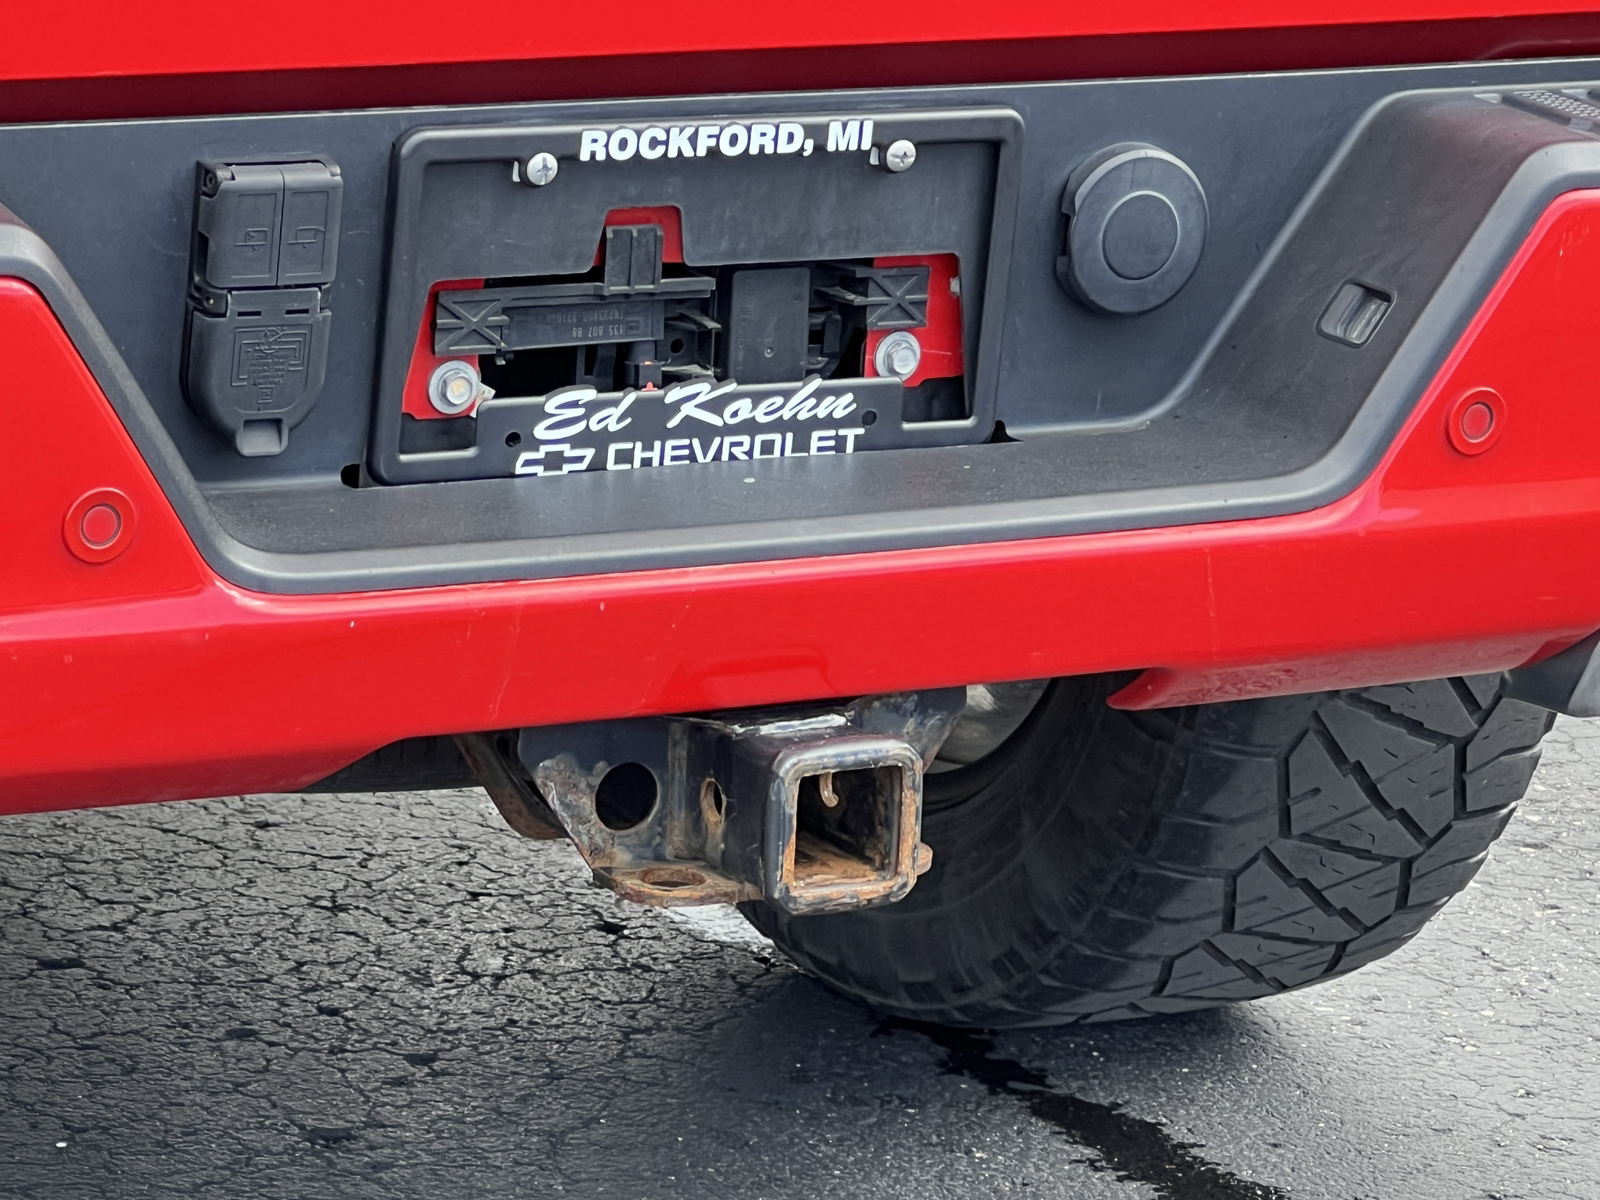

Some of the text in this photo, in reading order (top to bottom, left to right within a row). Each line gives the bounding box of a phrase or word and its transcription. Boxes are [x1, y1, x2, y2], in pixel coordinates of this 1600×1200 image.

[579, 120, 874, 161] ROCKFORD, MI
[532, 377, 857, 440] Ed Koehn
[606, 428, 866, 471] CHEVROLET
